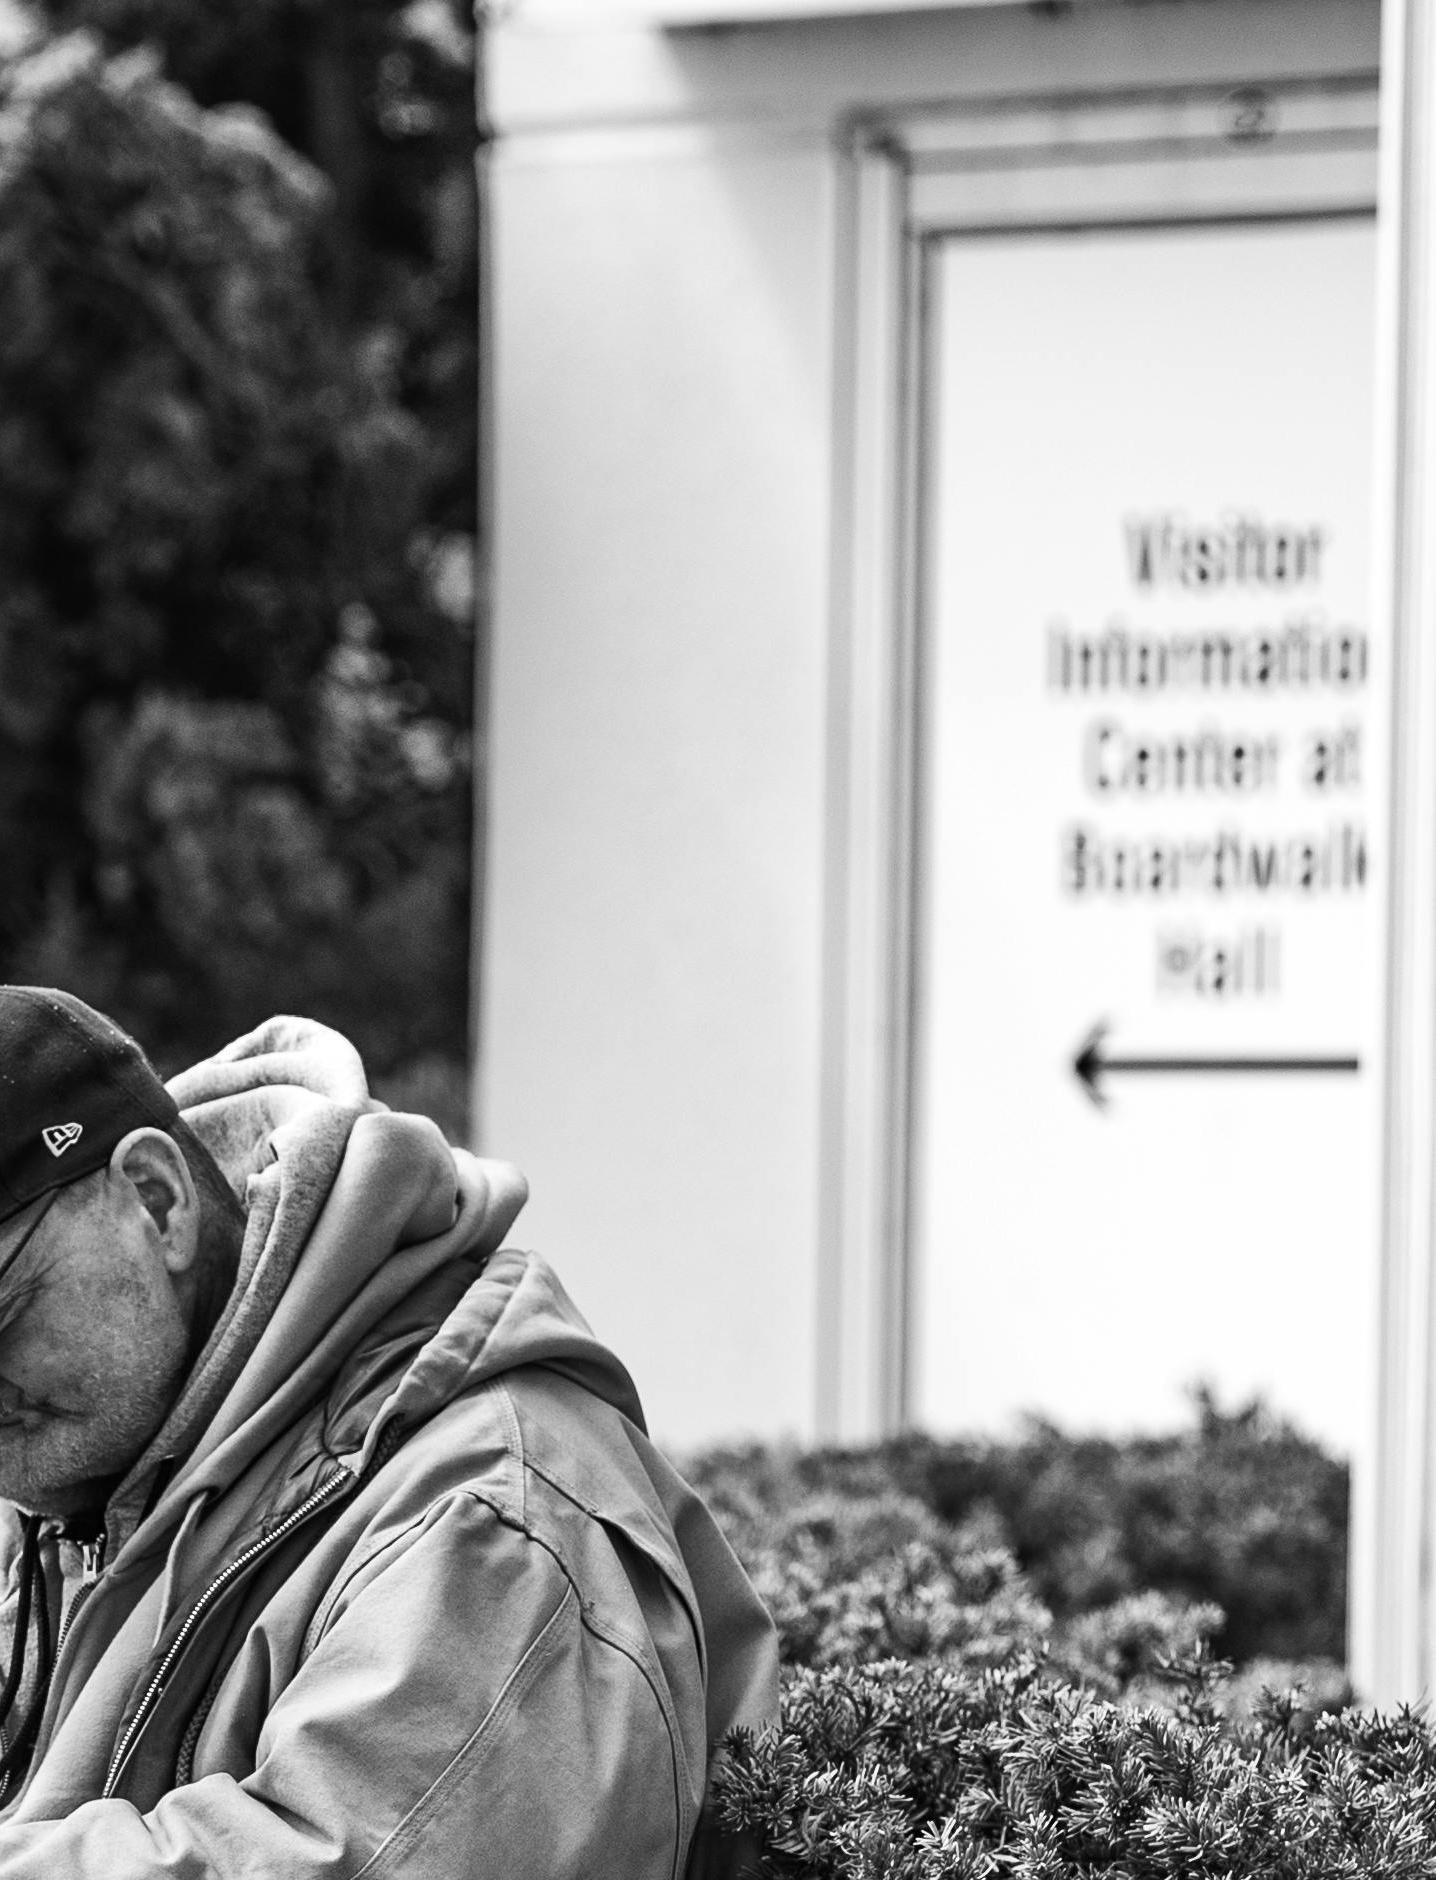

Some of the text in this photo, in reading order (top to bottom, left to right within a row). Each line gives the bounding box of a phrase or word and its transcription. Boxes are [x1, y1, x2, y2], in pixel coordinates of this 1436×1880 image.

[1125, 515, 1327, 586] Visitor
[1083, 718, 1279, 792] Center
[1153, 925, 1283, 994] Hall
